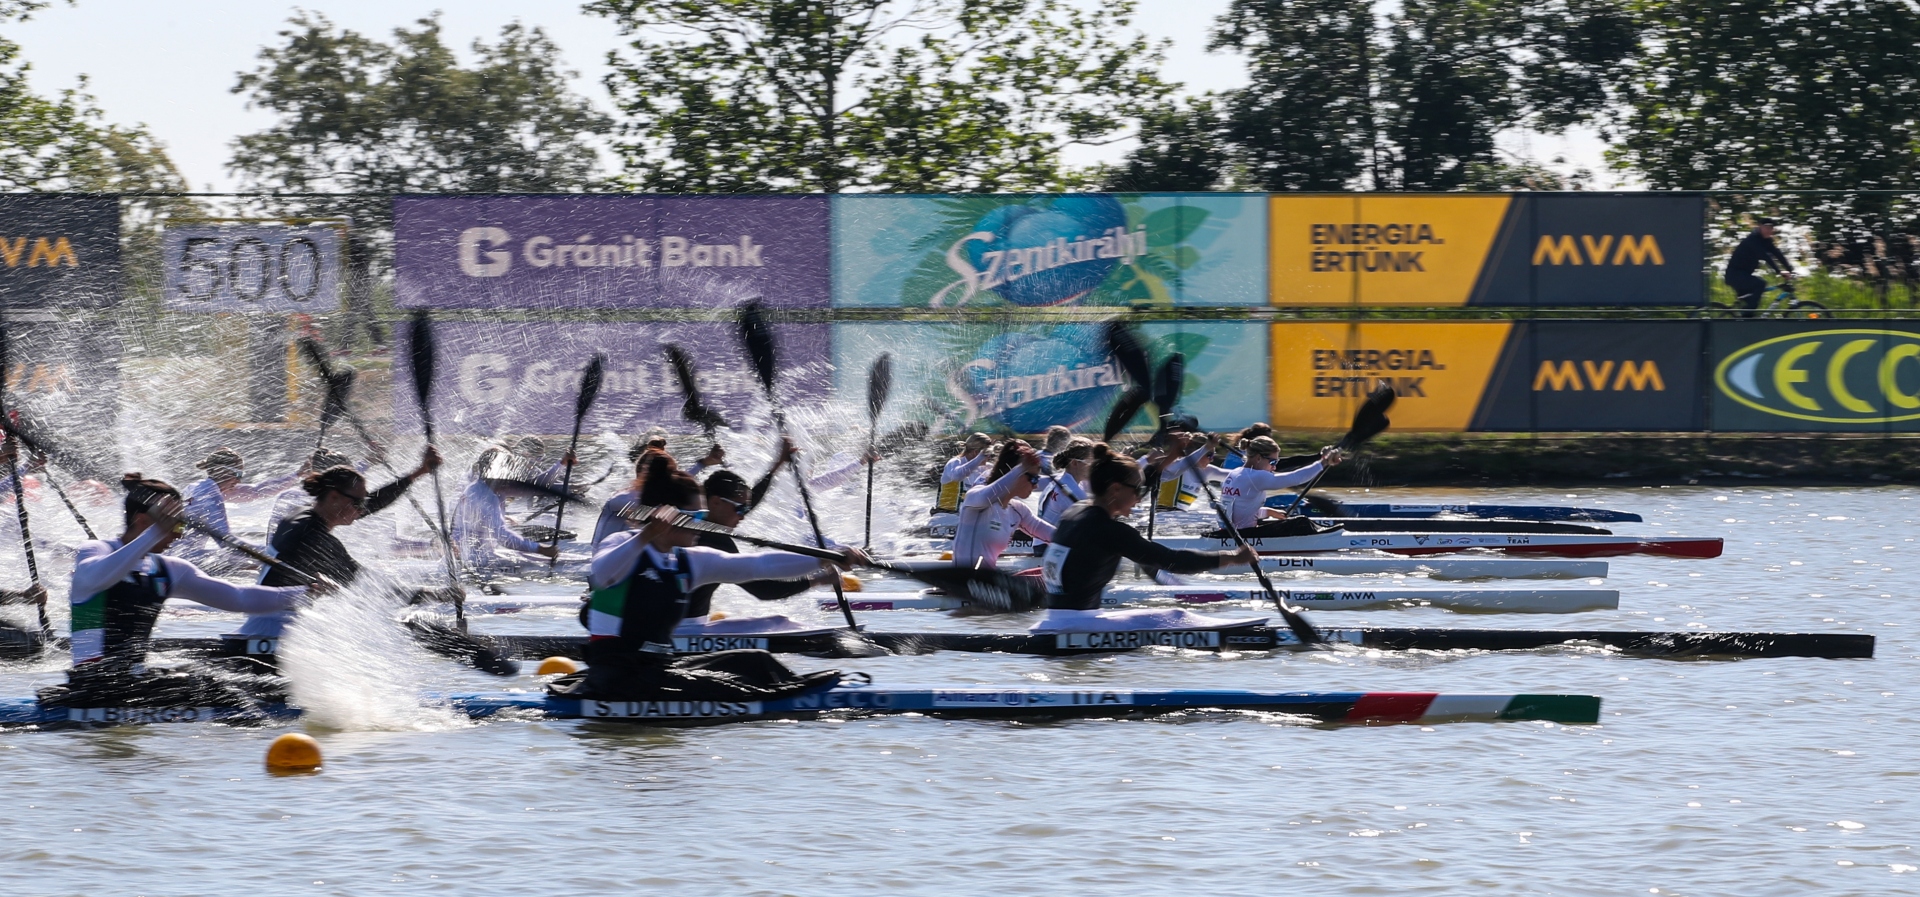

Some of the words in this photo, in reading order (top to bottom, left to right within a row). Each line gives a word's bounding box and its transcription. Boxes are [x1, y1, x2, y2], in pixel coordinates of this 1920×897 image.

[1309, 224, 1445, 244] ENERGIA.
[523, 234, 652, 267] Gránit
[661, 235, 765, 267] Bank
[1309, 246, 1426, 272] ÉRTÜNK
[1532, 235, 1665, 265] MVM
[178, 237, 320, 301] 500
[929, 224, 1147, 308] Szentkirályi
[1312, 349, 1446, 370] ENERGIA.
[1533, 360, 1665, 391] MVM
[1221, 538, 1231, 547] K.
[1371, 538, 1392, 546] POL
[1279, 559, 1314, 567] DEN
[1250, 589, 1291, 600] HUN
[1341, 592, 1376, 600] MVM
[688, 637, 757, 652] HOSKIN
[1067, 634, 1083, 648] L.
[1087, 632, 1210, 648] CARRINGTON
[593, 701, 618, 716] S.
[626, 701, 750, 716] DALDOSS
[1072, 690, 1122, 704] ITA
